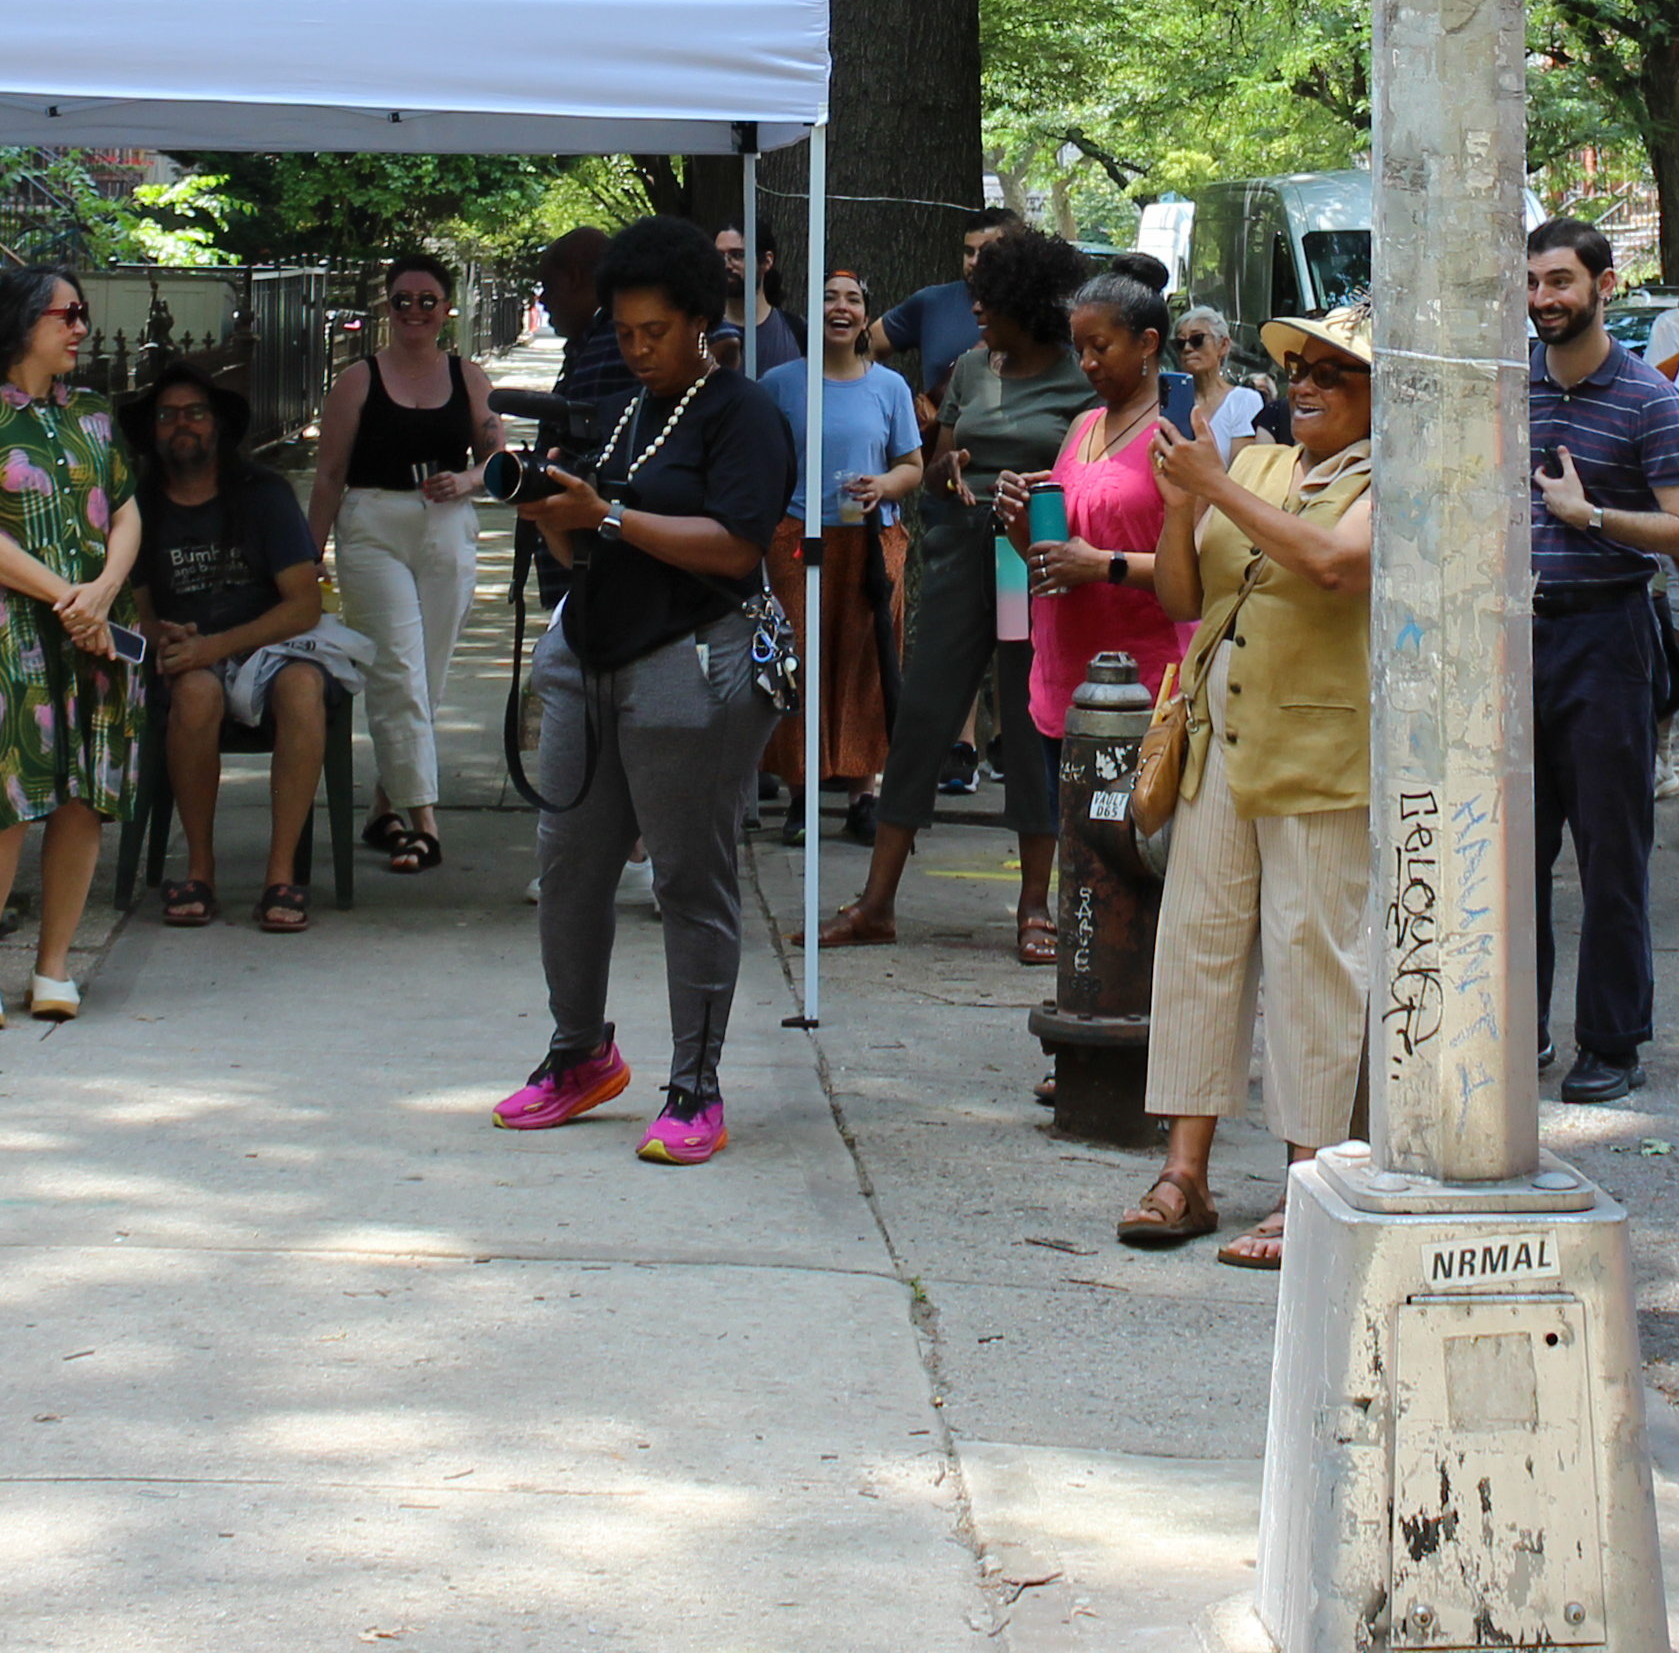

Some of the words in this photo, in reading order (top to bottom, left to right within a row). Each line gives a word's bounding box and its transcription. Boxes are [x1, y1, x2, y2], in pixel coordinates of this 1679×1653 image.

[170, 542, 242, 566] Bumbe
[1095, 792, 1125, 806] VAULT
[1432, 1239, 1552, 1281] NRMAL
